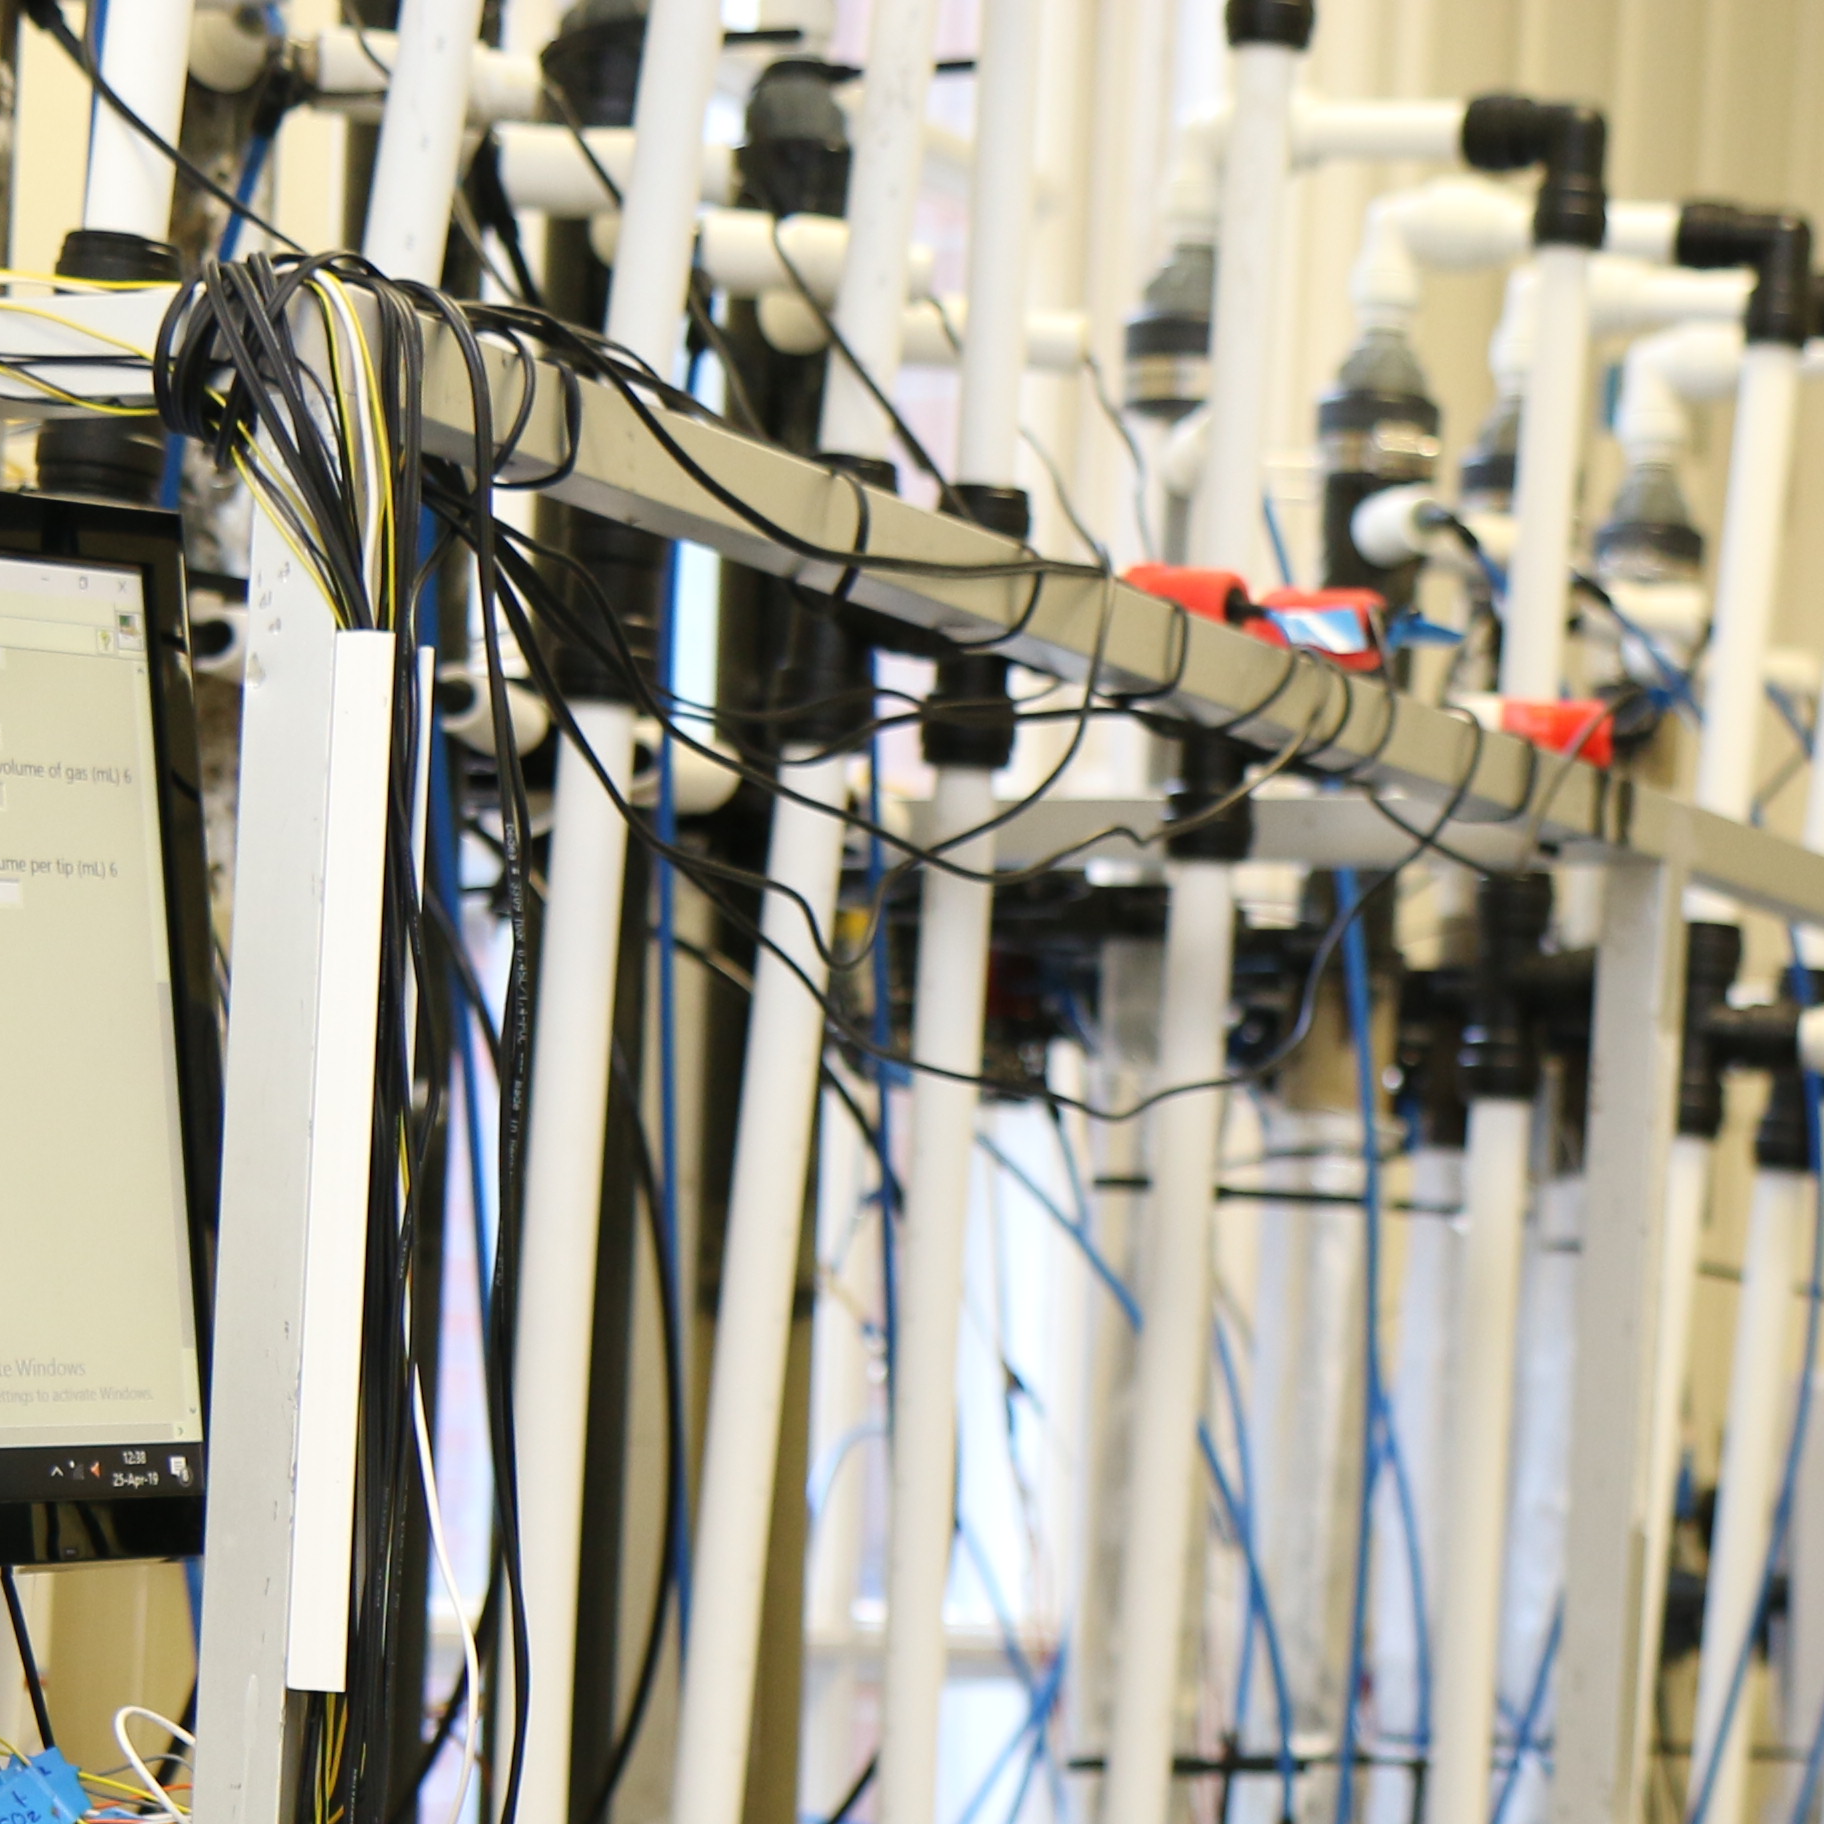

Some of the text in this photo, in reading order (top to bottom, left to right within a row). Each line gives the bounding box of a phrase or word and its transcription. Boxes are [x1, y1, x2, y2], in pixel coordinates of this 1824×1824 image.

[48, 762, 61, 778] of
[66, 767, 88, 784] gas
[92, 766, 120, 786] (mL)
[124, 769, 132, 784] 6
[31, 859, 52, 876] per
[57, 858, 74, 877] tip
[77, 860, 106, 879] (mL)
[109, 862, 118, 877] 6
[17, 1358, 86, 1377] Windows
[36, 1390, 49, 1402] to
[52, 1388, 97, 1401] activate
[112, 1472, 159, 1488] 25-Apr-19
